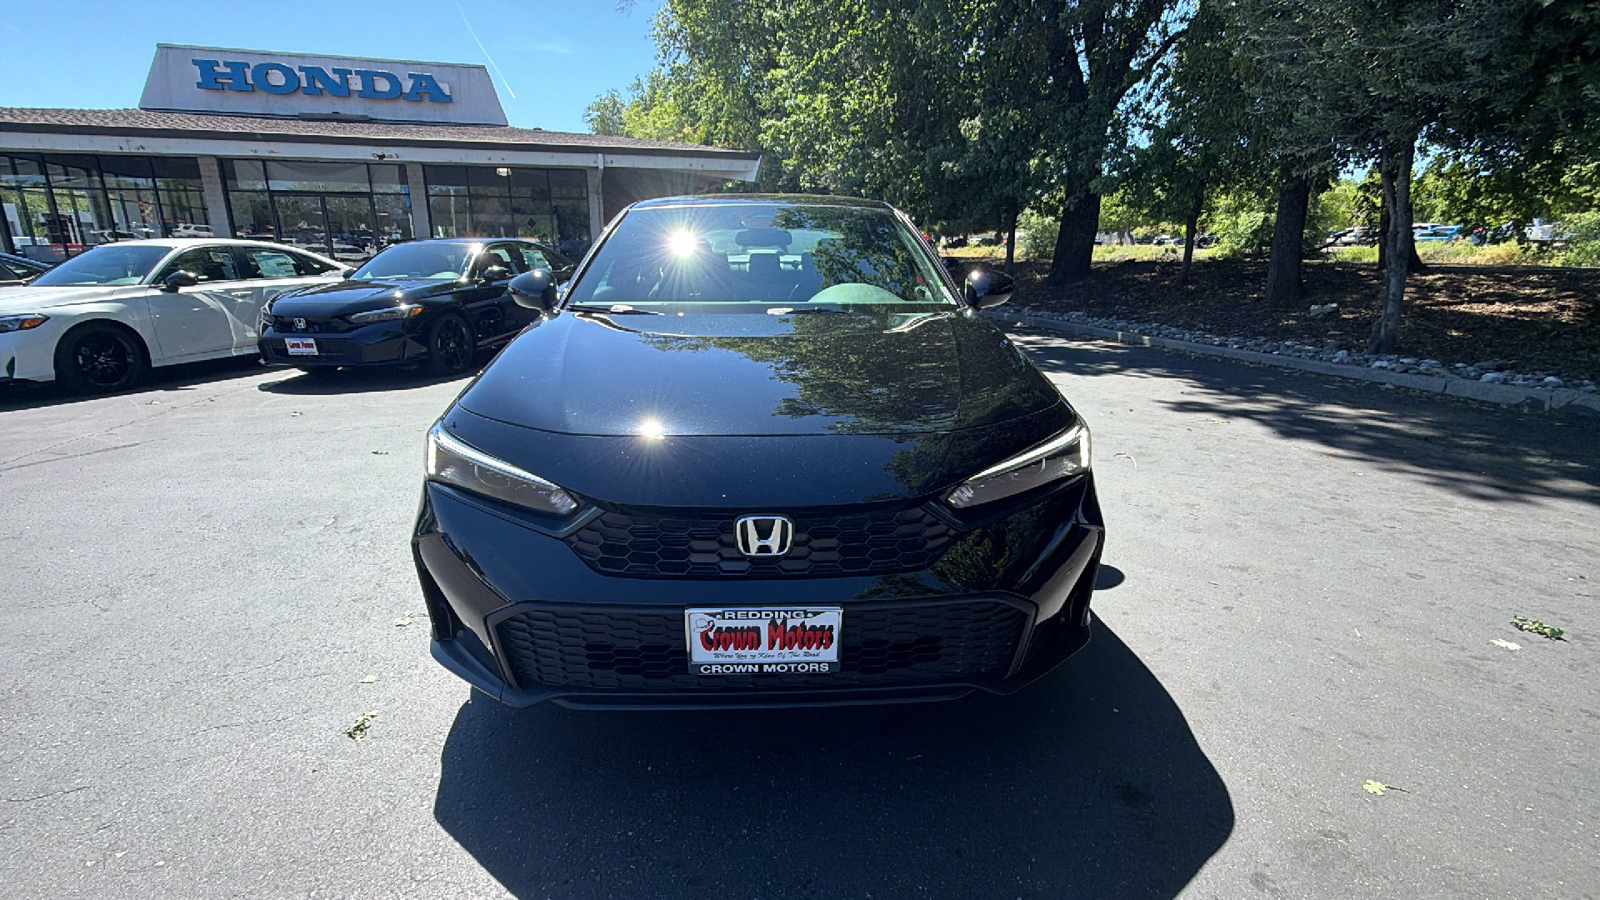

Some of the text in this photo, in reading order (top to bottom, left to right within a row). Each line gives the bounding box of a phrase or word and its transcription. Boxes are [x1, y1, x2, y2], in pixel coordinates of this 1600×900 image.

[191, 58, 453, 104] HONDA
[724, 611, 805, 619] REDDING
[700, 619, 834, 651] Crown Motors
[700, 663, 830, 673] CROWN MOTORS
